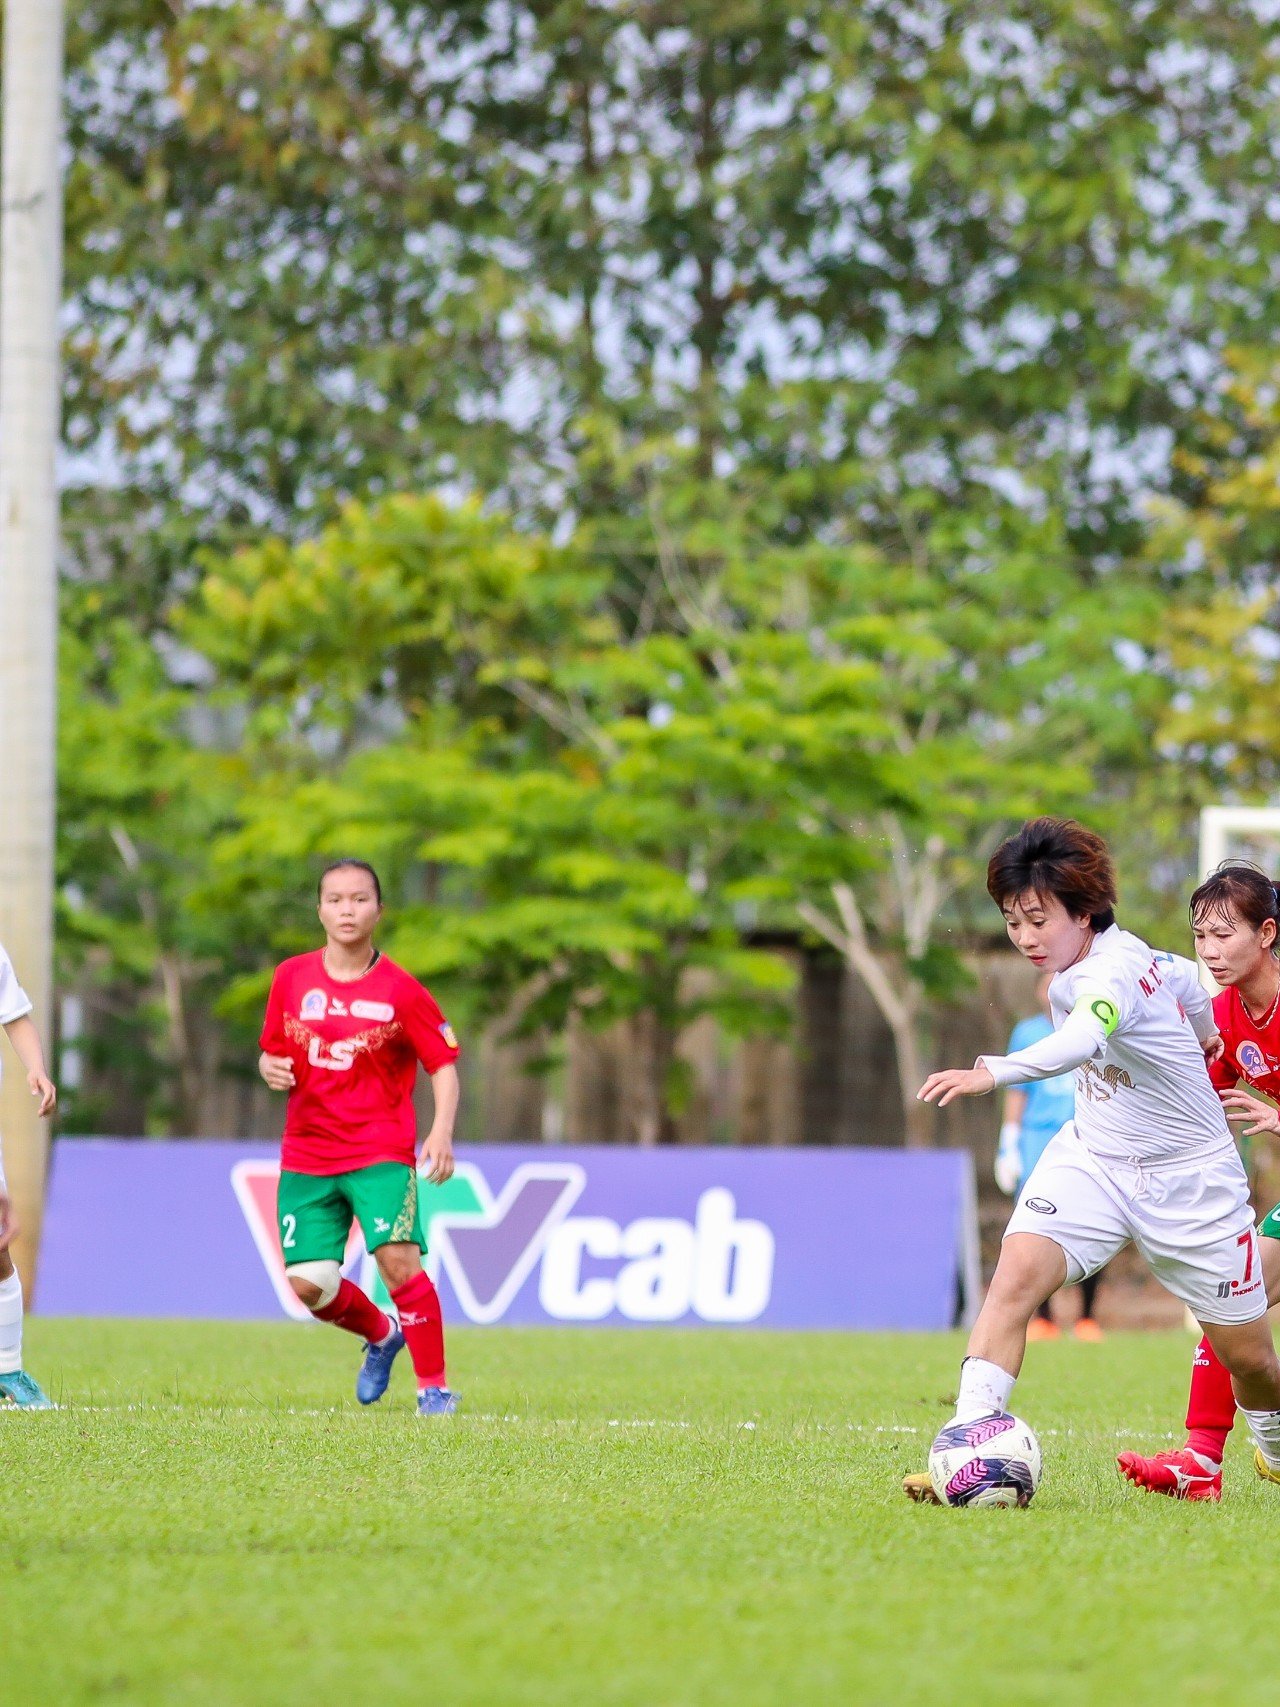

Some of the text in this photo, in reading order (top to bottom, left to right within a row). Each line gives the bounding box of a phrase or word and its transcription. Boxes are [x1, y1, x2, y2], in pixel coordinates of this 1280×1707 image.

[1091, 1000, 1113, 1024] C
[308, 1037, 355, 1071] LS
[282, 1213, 296, 1248] 2
[1236, 1229, 1254, 1284] 7
